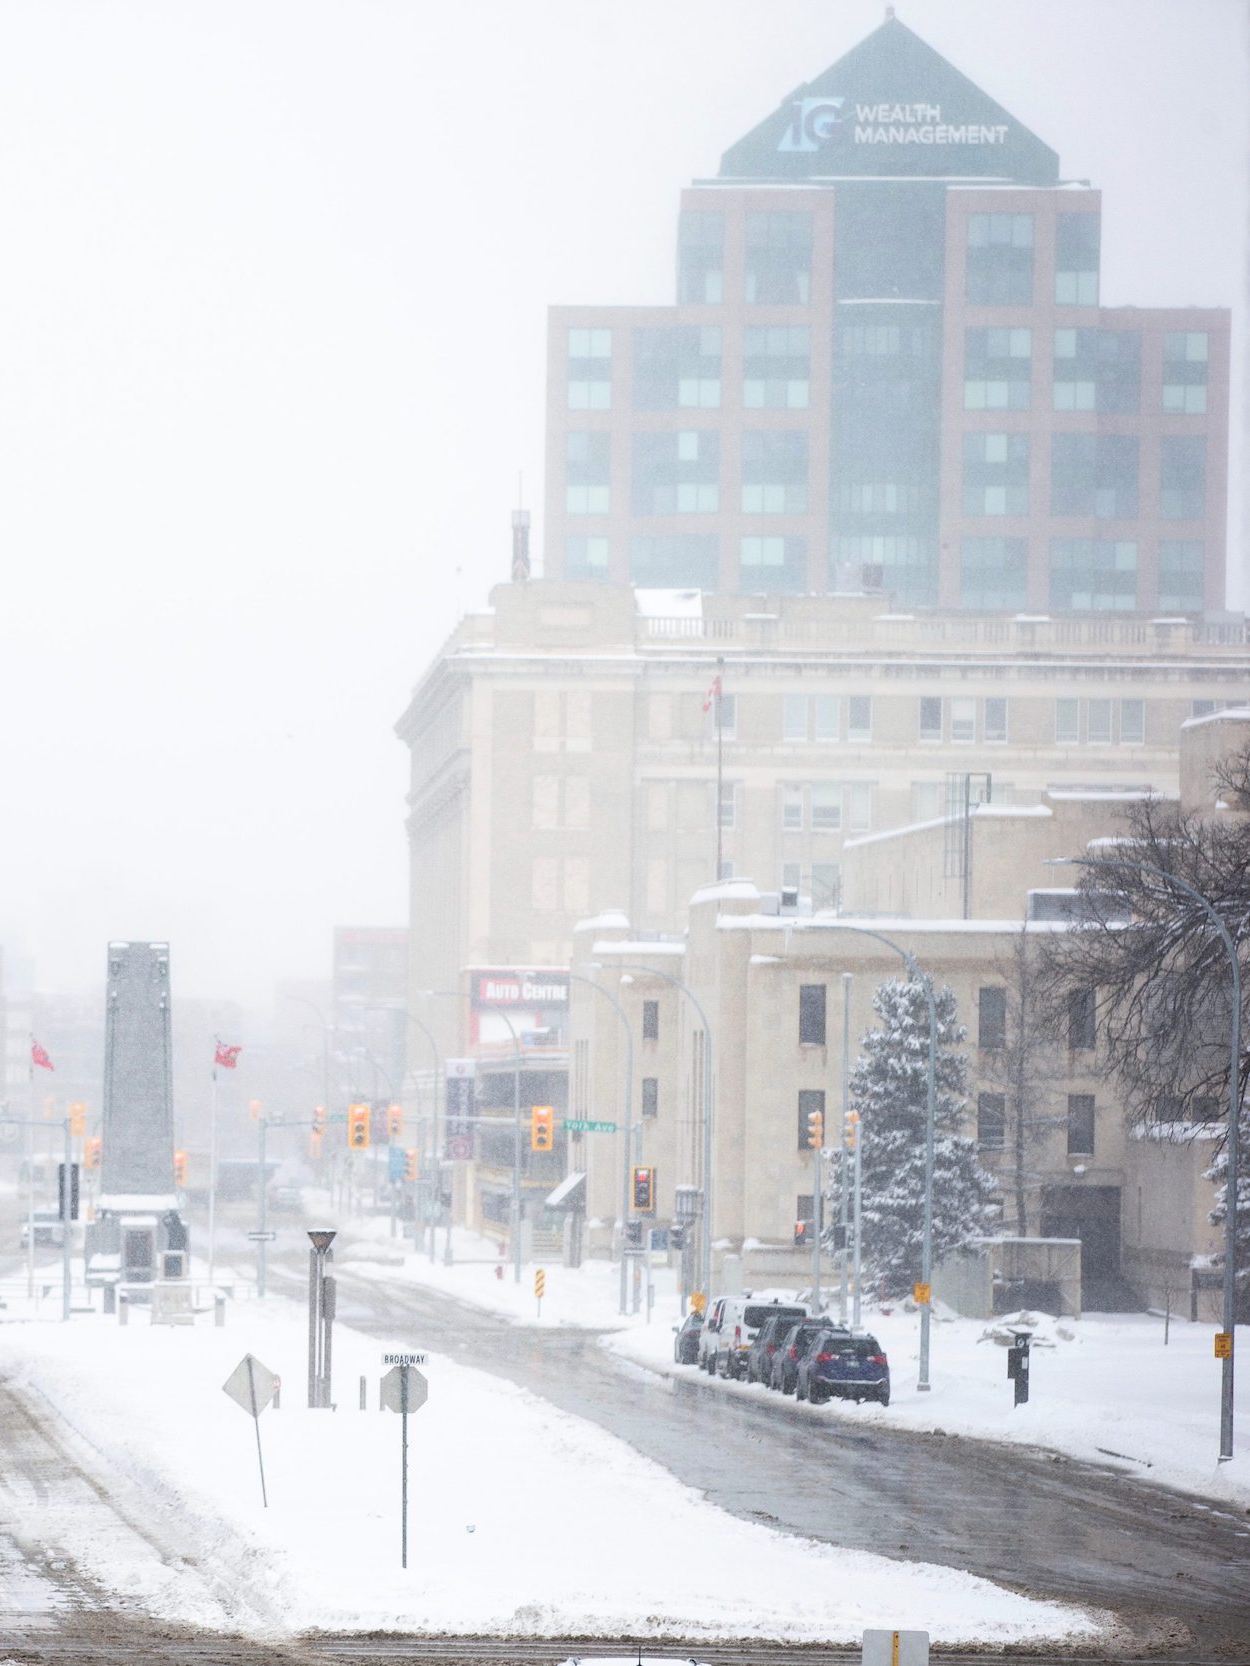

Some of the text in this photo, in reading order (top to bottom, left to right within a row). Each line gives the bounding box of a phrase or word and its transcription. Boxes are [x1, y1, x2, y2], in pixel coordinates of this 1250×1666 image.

[855, 103, 941, 123] WEALTH
[853, 124, 1009, 145] MANAGEMENT
[486, 981, 568, 1001] AUTO CENTRE
[384, 1354, 425, 1364] BROADWAY
